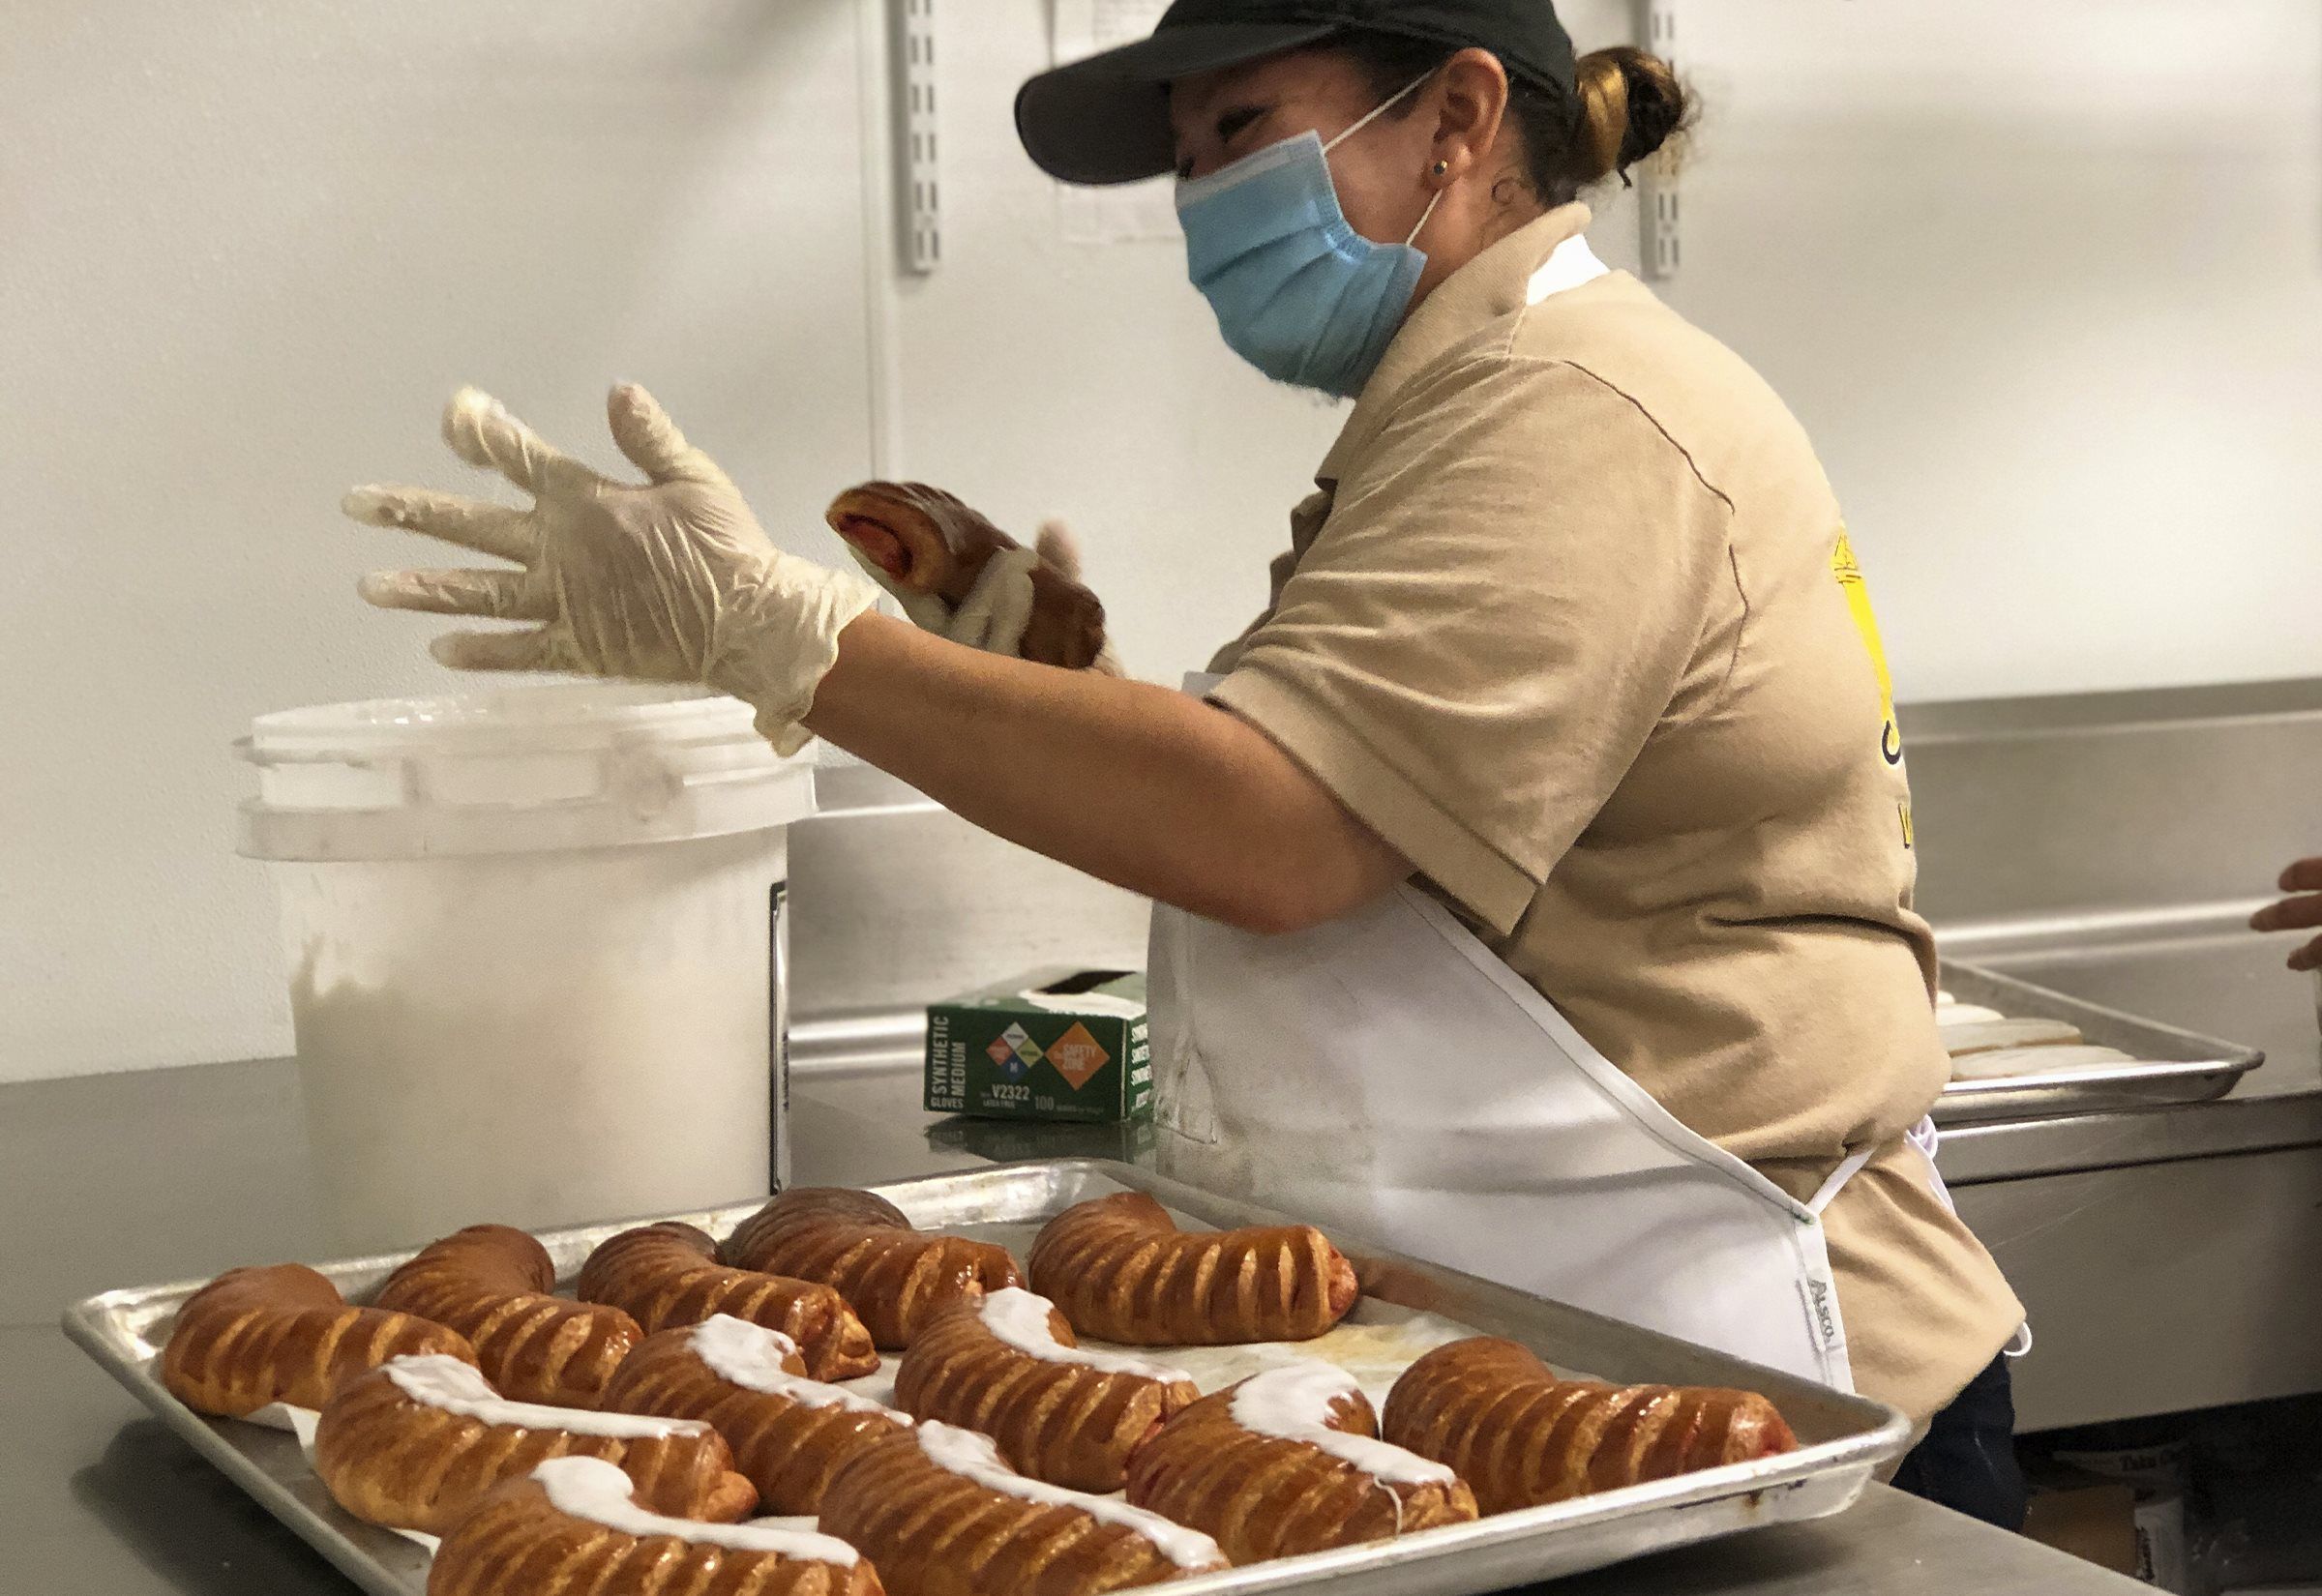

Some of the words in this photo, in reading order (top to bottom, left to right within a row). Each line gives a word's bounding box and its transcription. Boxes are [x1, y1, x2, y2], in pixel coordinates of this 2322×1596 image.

[932, 1016, 948, 1094] SYNTHETIC
[951, 1042, 966, 1097] MEDIUM
[992, 1084, 1029, 1101] V2322
[931, 1096, 964, 1109] GLOVES
[1034, 1096, 1055, 1110] 100
